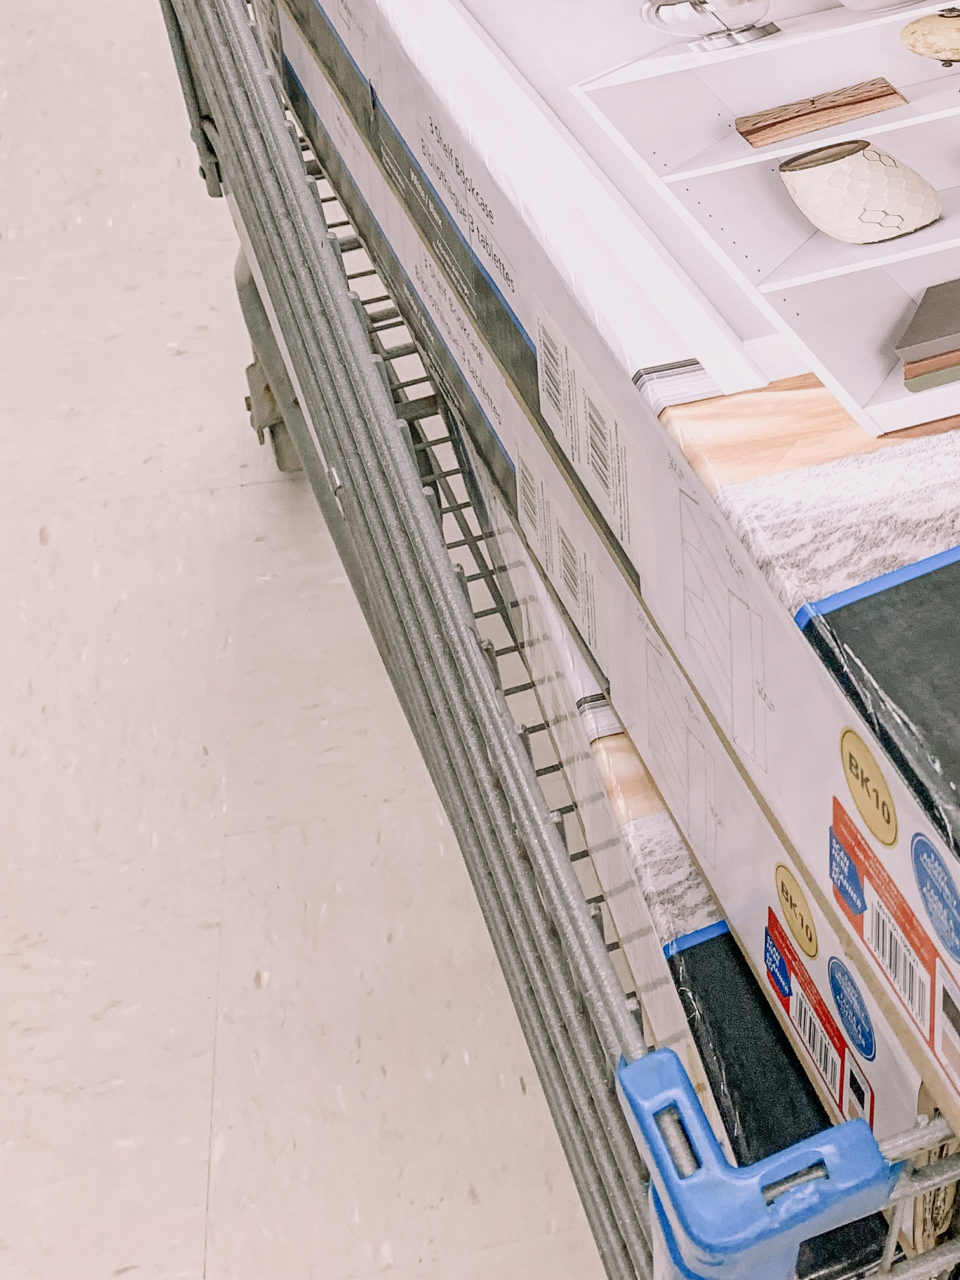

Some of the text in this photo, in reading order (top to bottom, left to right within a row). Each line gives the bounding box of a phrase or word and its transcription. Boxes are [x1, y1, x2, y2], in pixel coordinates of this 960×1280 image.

[454, 157, 495, 225] Bookcase
[476, 225, 516, 293] tablettes
[848, 751, 892, 826] BK10
[780, 881, 813, 943] BK10
[832, 861, 862, 910] SCANNER
